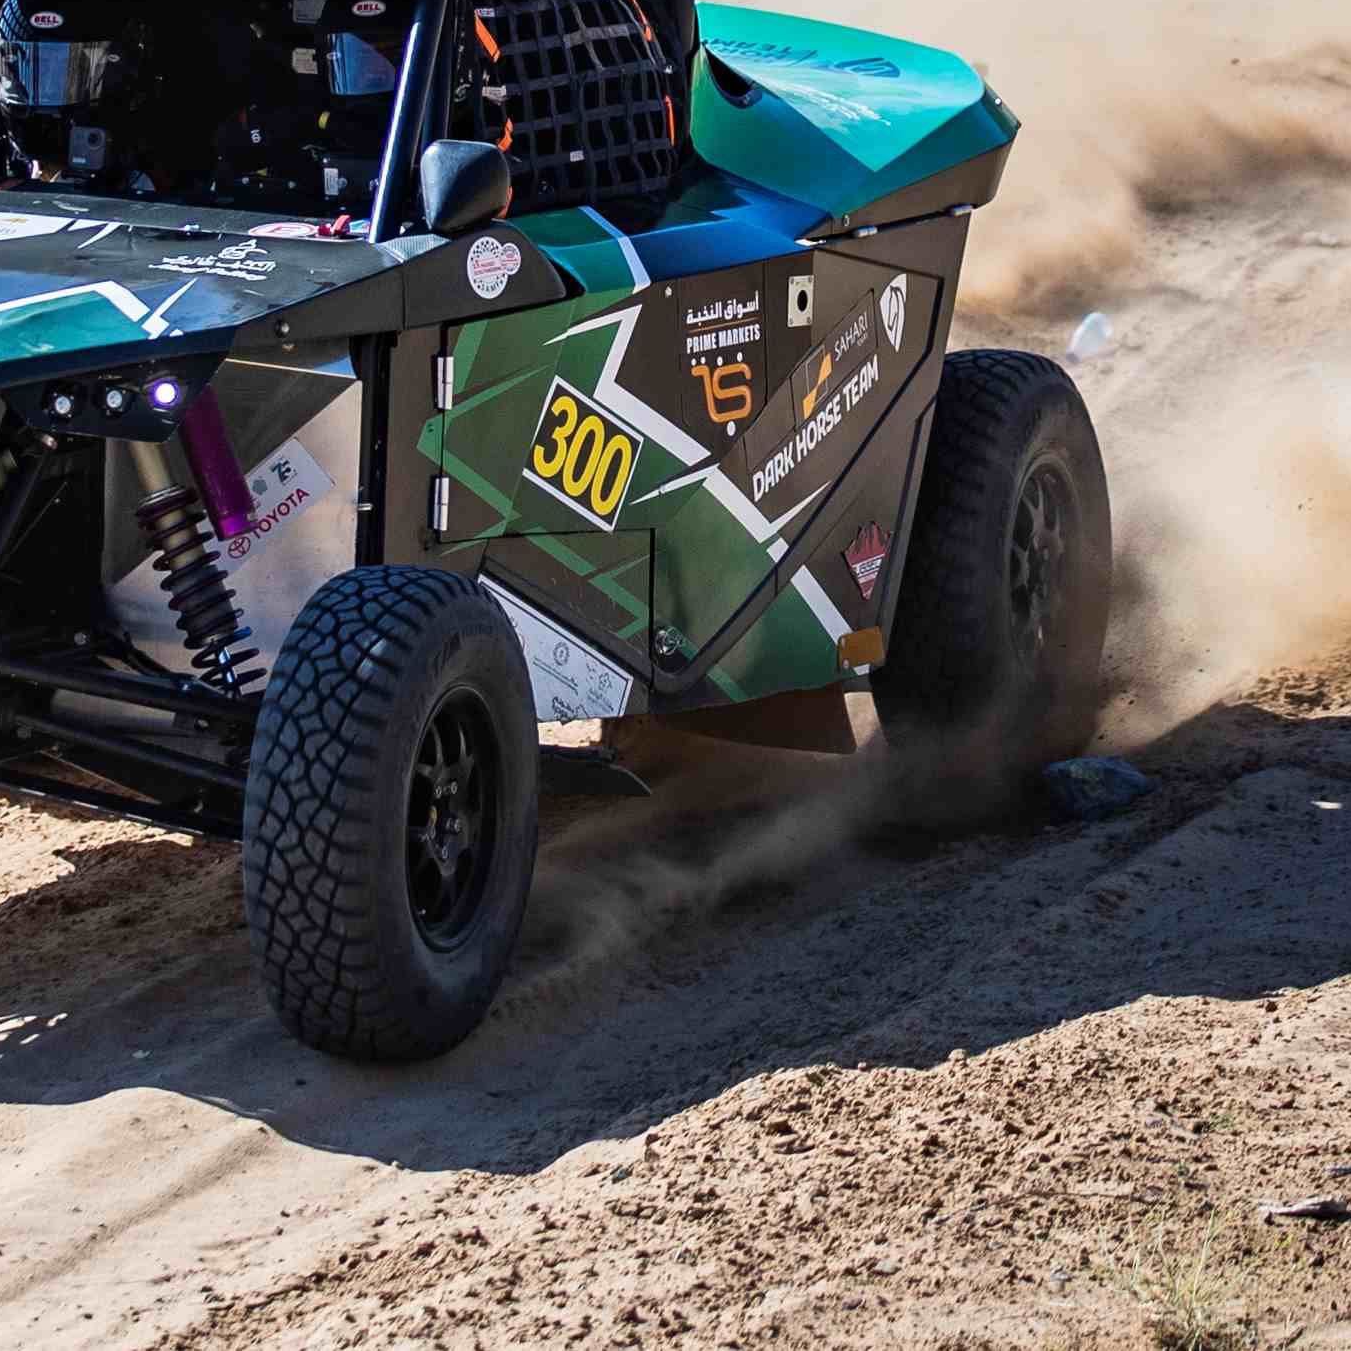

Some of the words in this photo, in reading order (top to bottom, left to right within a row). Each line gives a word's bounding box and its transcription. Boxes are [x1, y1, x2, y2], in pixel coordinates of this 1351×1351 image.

[686, 301, 723, 326] النخبة
[686, 336, 718, 354] PRIME
[718, 324, 761, 348] MARKETS
[834, 311, 869, 362] SAHARI
[752, 441, 795, 503] DARK
[795, 393, 842, 463] HORSE
[842, 353, 880, 413] TEAM
[533, 395, 632, 516] 300
[251, 487, 310, 539] TOYOTA
